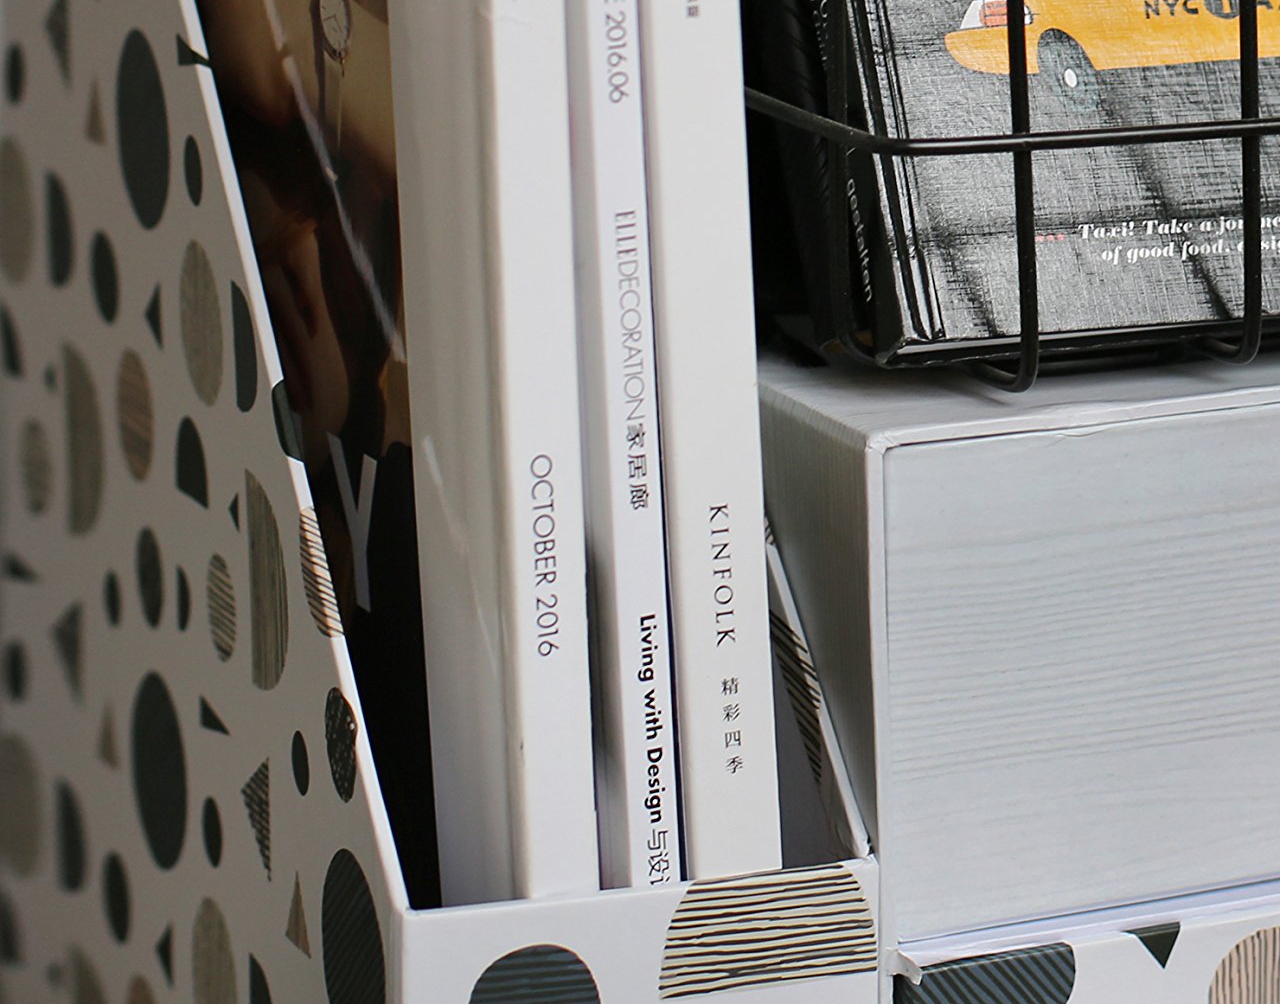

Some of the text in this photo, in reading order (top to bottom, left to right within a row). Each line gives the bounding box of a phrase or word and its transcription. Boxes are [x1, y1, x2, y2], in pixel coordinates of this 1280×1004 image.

[604, 10, 631, 105] 2016.06
[1077, 221, 1136, 241] Taxi!
[1142, 218, 1194, 237] Take
[1199, 219, 1212, 232] a
[1101, 245, 1124, 266] of
[1126, 242, 1175, 265] good
[529, 453, 560, 657] OCTOBER 2016
[709, 501, 737, 647] KINFOLK
[637, 612, 656, 683] Living
[642, 688, 664, 741] with
[719, 676, 745, 776] 精彩四季
[643, 747, 665, 824] Design
